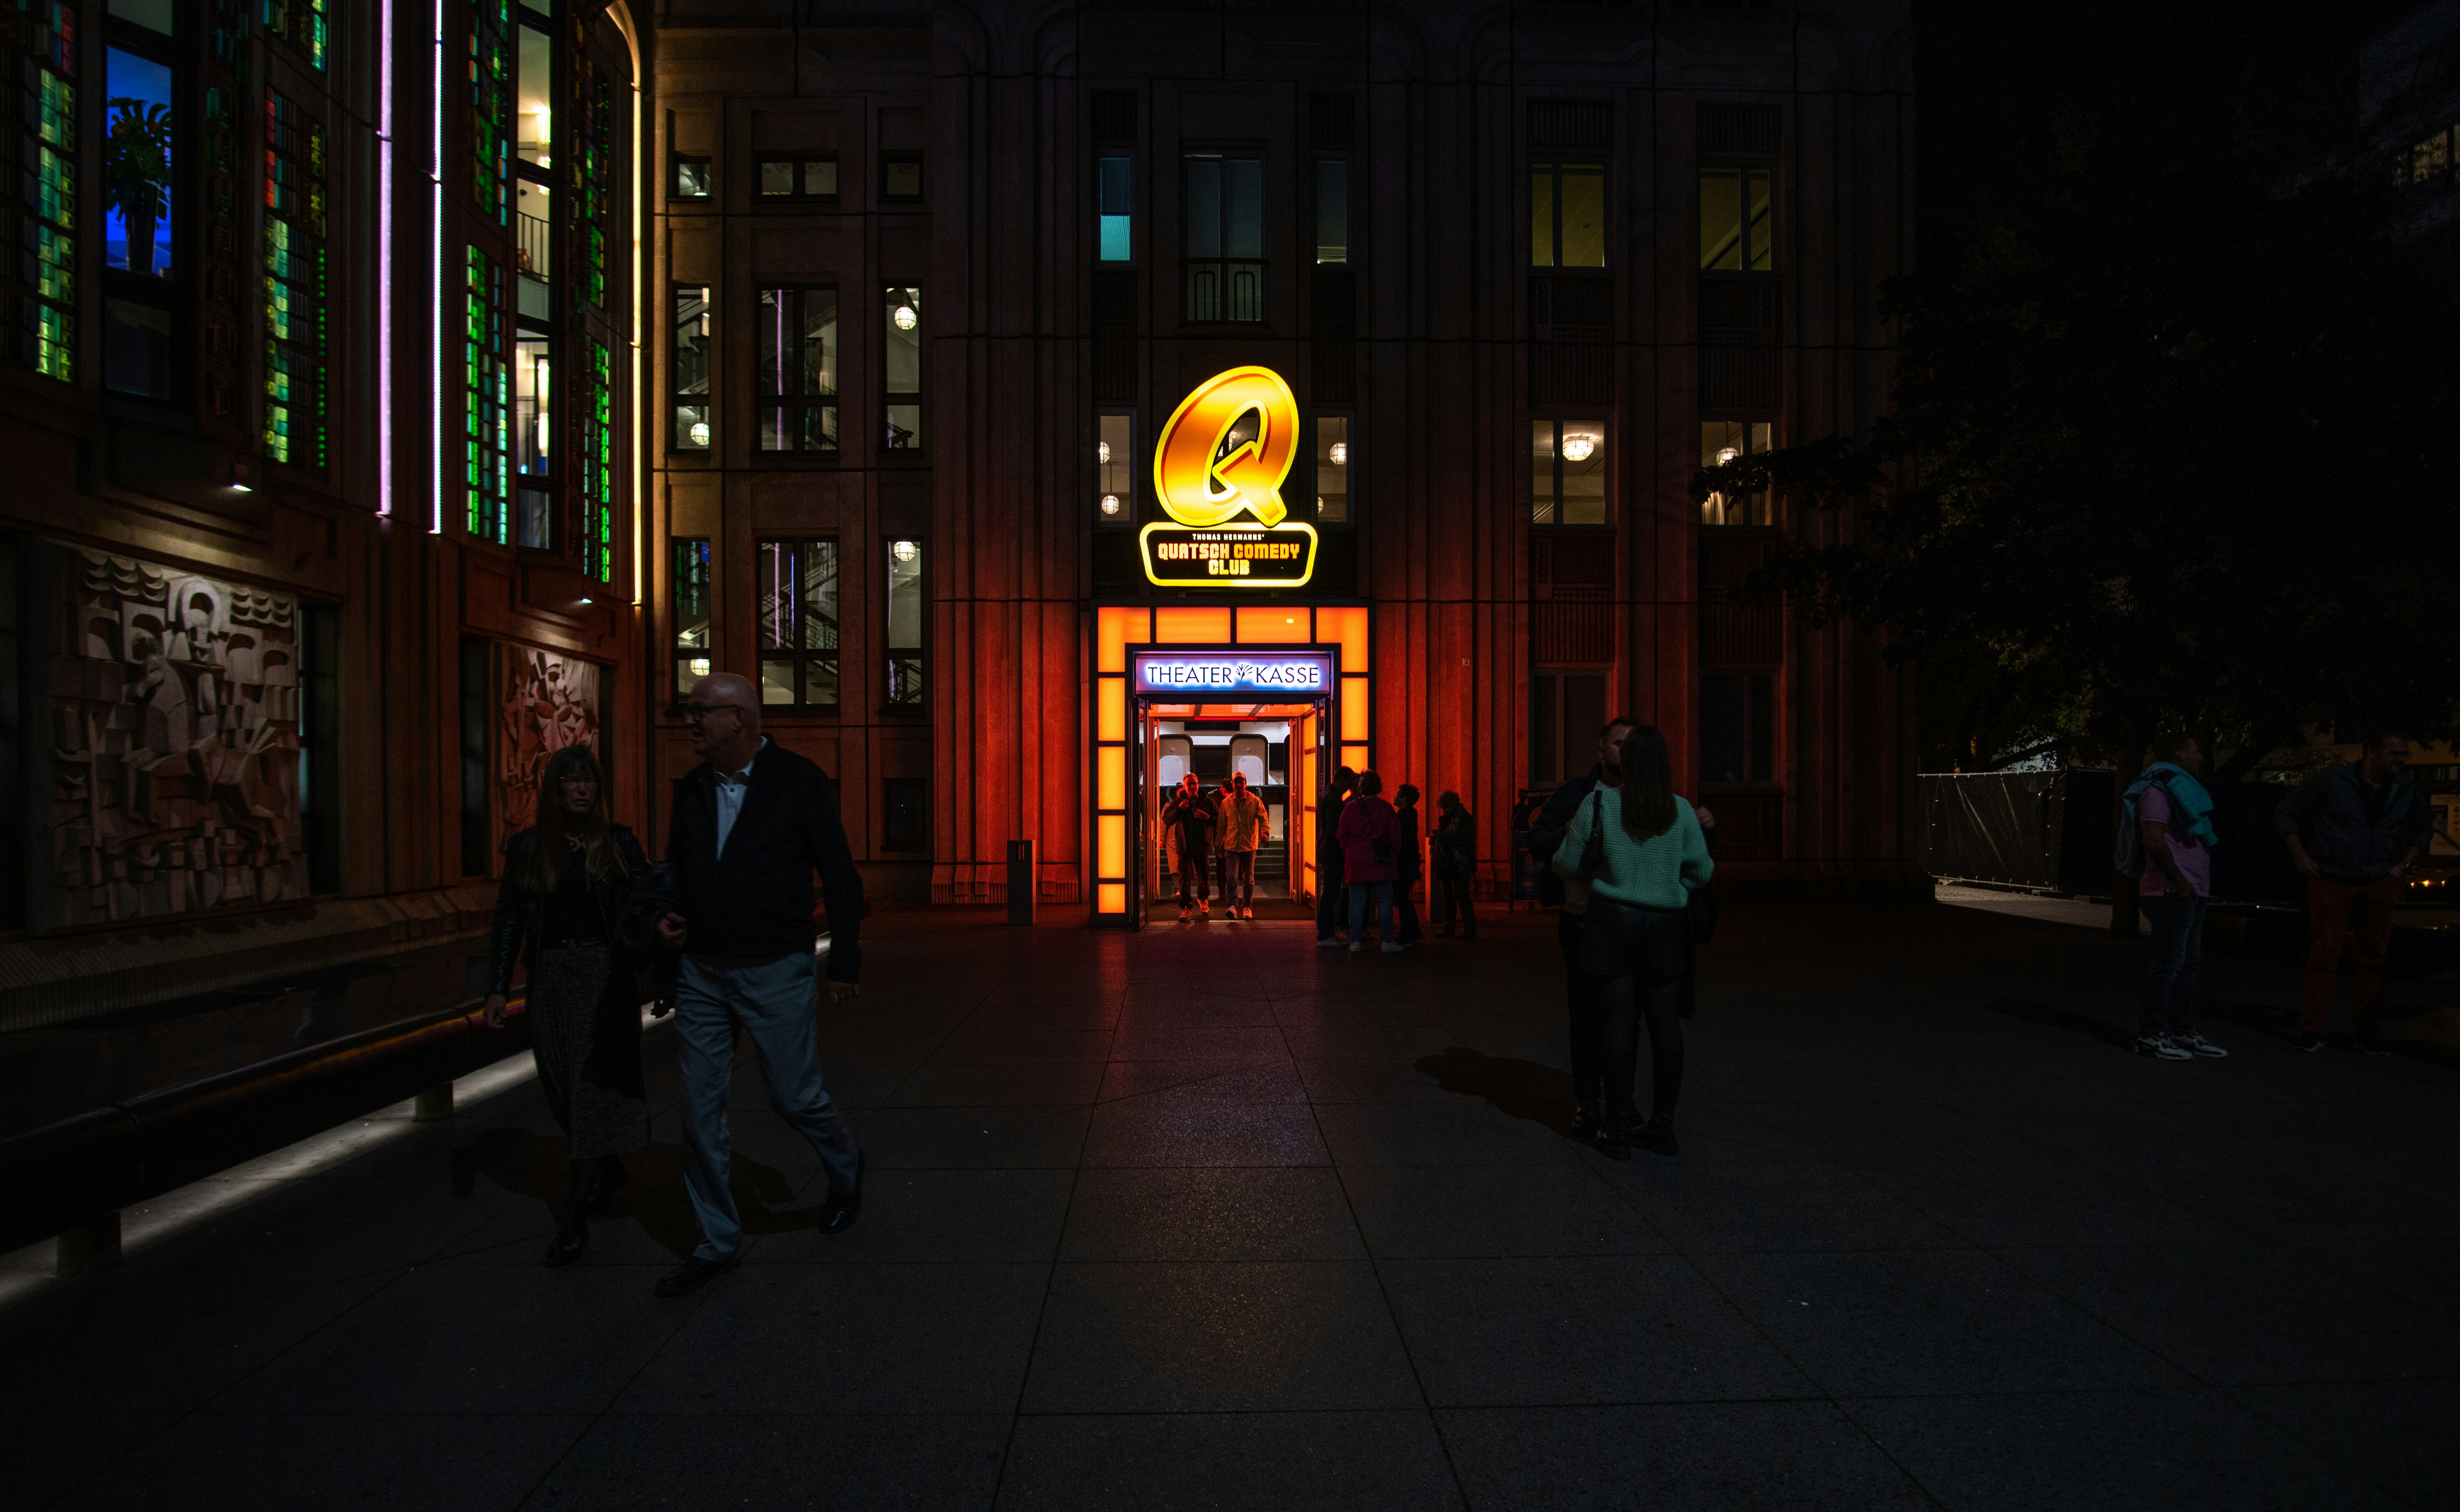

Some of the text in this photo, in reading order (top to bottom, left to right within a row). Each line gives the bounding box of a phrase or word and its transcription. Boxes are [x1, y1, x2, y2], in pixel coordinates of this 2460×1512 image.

[1153, 365, 1299, 527] Q
[1158, 543, 1300, 560] QUATSCH COMEDY
[1209, 559, 1250, 575] CLUB
[1148, 666, 1318, 683] THEATER KASSE
